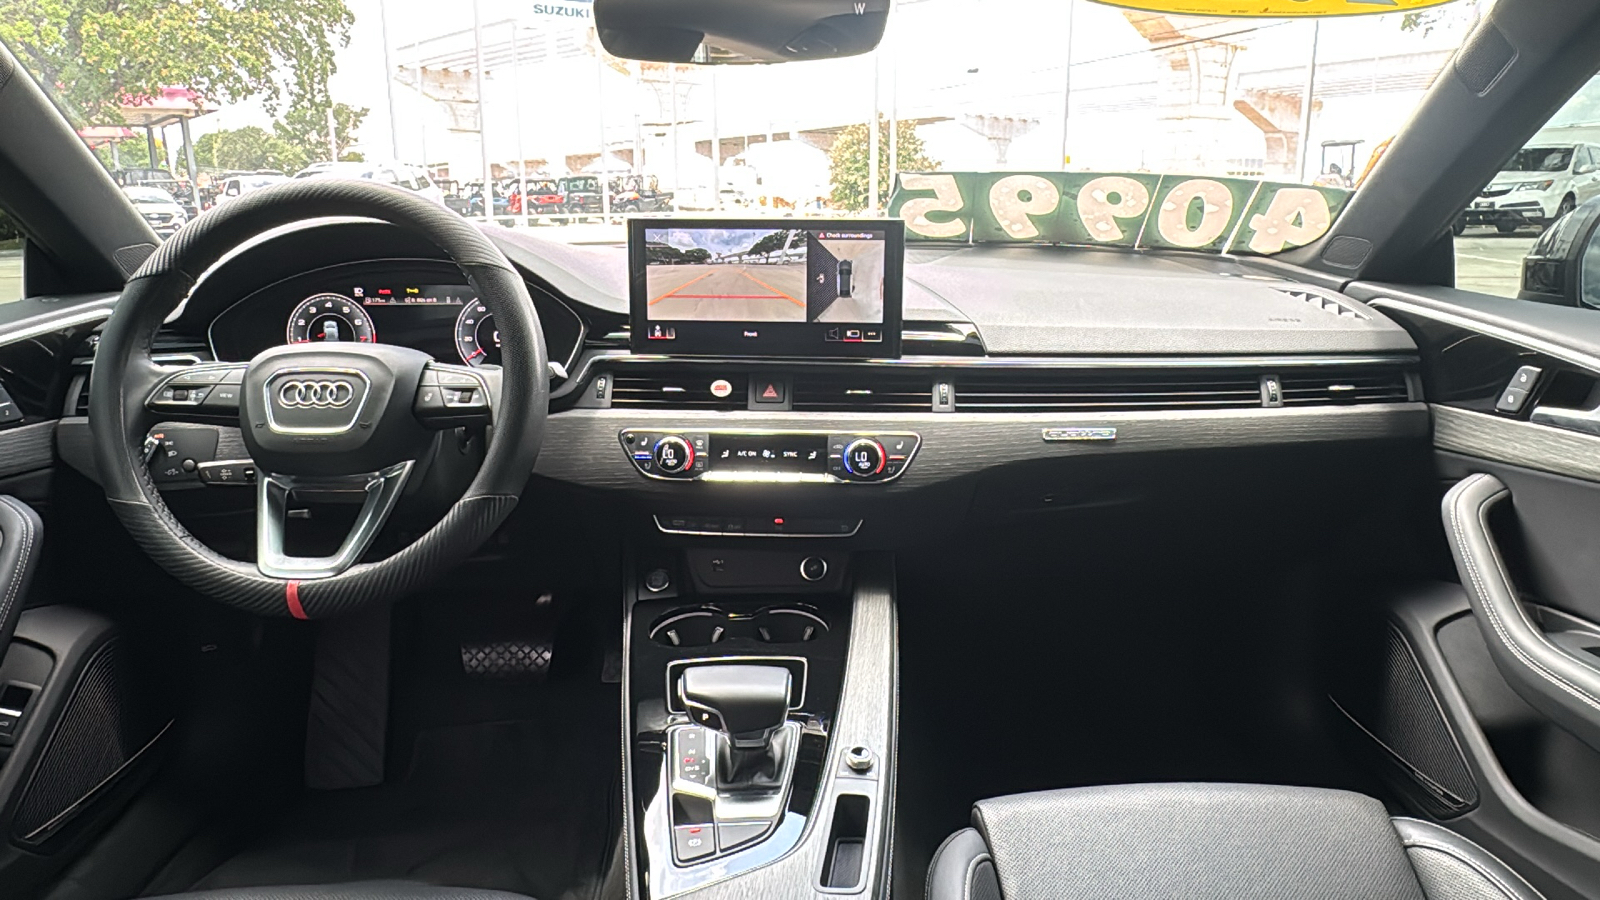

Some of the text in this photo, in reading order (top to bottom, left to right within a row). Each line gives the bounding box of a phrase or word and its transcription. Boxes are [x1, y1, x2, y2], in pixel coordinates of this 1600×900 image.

[533, 4, 590, 18] SUZUKI
[854, 3, 866, 15] W
[309, 306, 317, 314] 3
[342, 306, 351, 314] 5
[854, 451, 868, 462] LO
[702, 713, 709, 721] P
